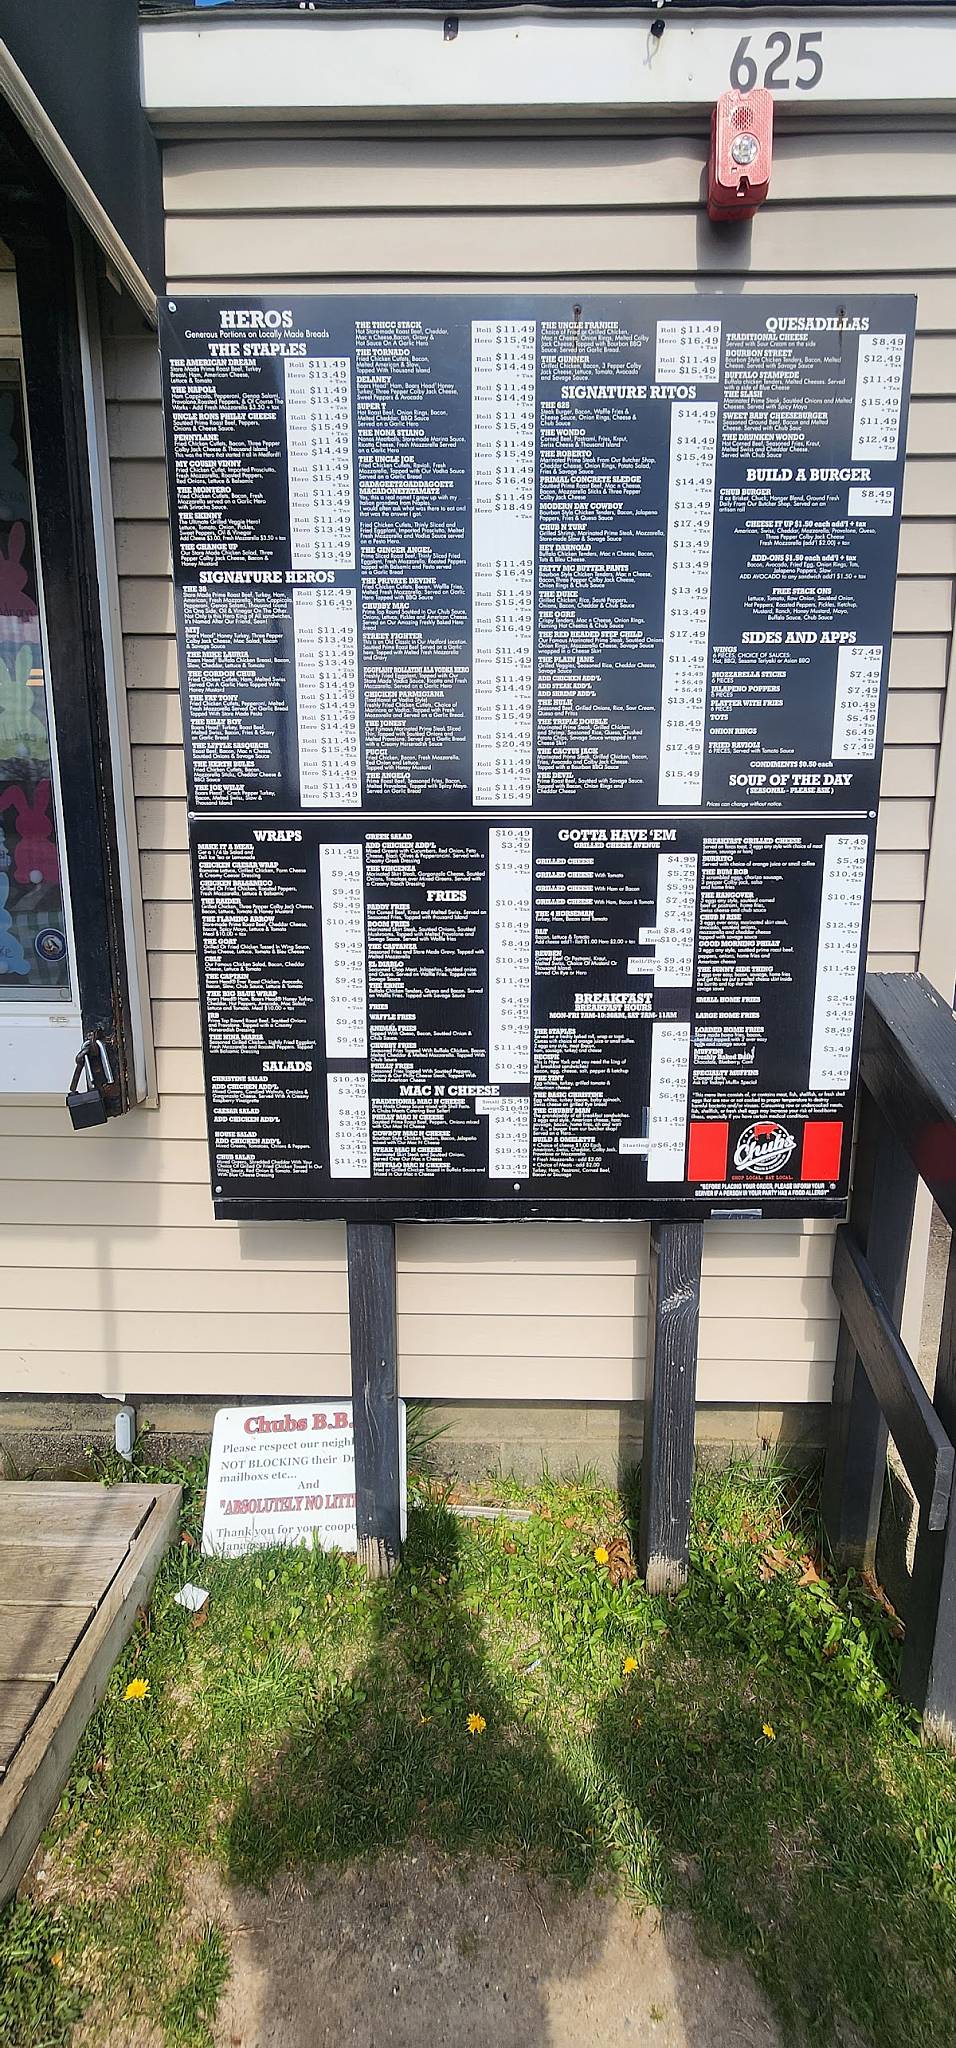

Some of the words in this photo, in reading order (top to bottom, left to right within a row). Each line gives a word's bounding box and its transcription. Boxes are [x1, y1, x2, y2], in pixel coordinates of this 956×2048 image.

[730, 31, 823, 94] 625
[220, 310, 293, 328] HEROS
[766, 317, 869, 332] QUESADILLAS
[208, 343, 240, 356] THE
[243, 343, 306, 356] STAPLES
[562, 386, 647, 399] SIGNATURE
[650, 386, 696, 399] RITOS
[746, 469, 792, 481] BUILD
[796, 469, 806, 481] A
[810, 468, 871, 481] BURGER
[200, 571, 282, 583] SIGNATURE
[285, 571, 335, 584] HEROS
[742, 632, 782, 643] SIDES
[785, 632, 817, 643] AND
[820, 632, 856, 643] APPS
[729, 774, 766, 786] SOUP
[769, 774, 790, 786] OF
[792, 774, 821, 785] THE
[823, 774, 852, 785] DAY
[253, 830, 302, 841] WRAPS
[427, 890, 467, 901] FRIES
[575, 994, 652, 1004] BREAKFAST
[263, 1061, 312, 1071] SALADS
[400, 1086, 431, 1096] MAC
[434, 1086, 445, 1096] N
[448, 1086, 500, 1096] CHEESE
[734, 1134, 796, 1166] Chubs
[244, 1414, 307, 1434] Chubs
[223, 1444, 256, 1453] Please
[260, 1441, 297, 1452] respect
[221, 1461, 246, 1470] NOT
[249, 1457, 308, 1468] BLOCKING
[312, 1456, 337, 1464] their
[220, 1472, 268, 1482] mailboxs
[298, 1480, 319, 1489] And
[304, 1495, 323, 1511] NO
[216, 1527, 251, 1538] Thank
[254, 1528, 274, 1537] you
[278, 1525, 296, 1534] for
[298, 1525, 321, 1534] your
